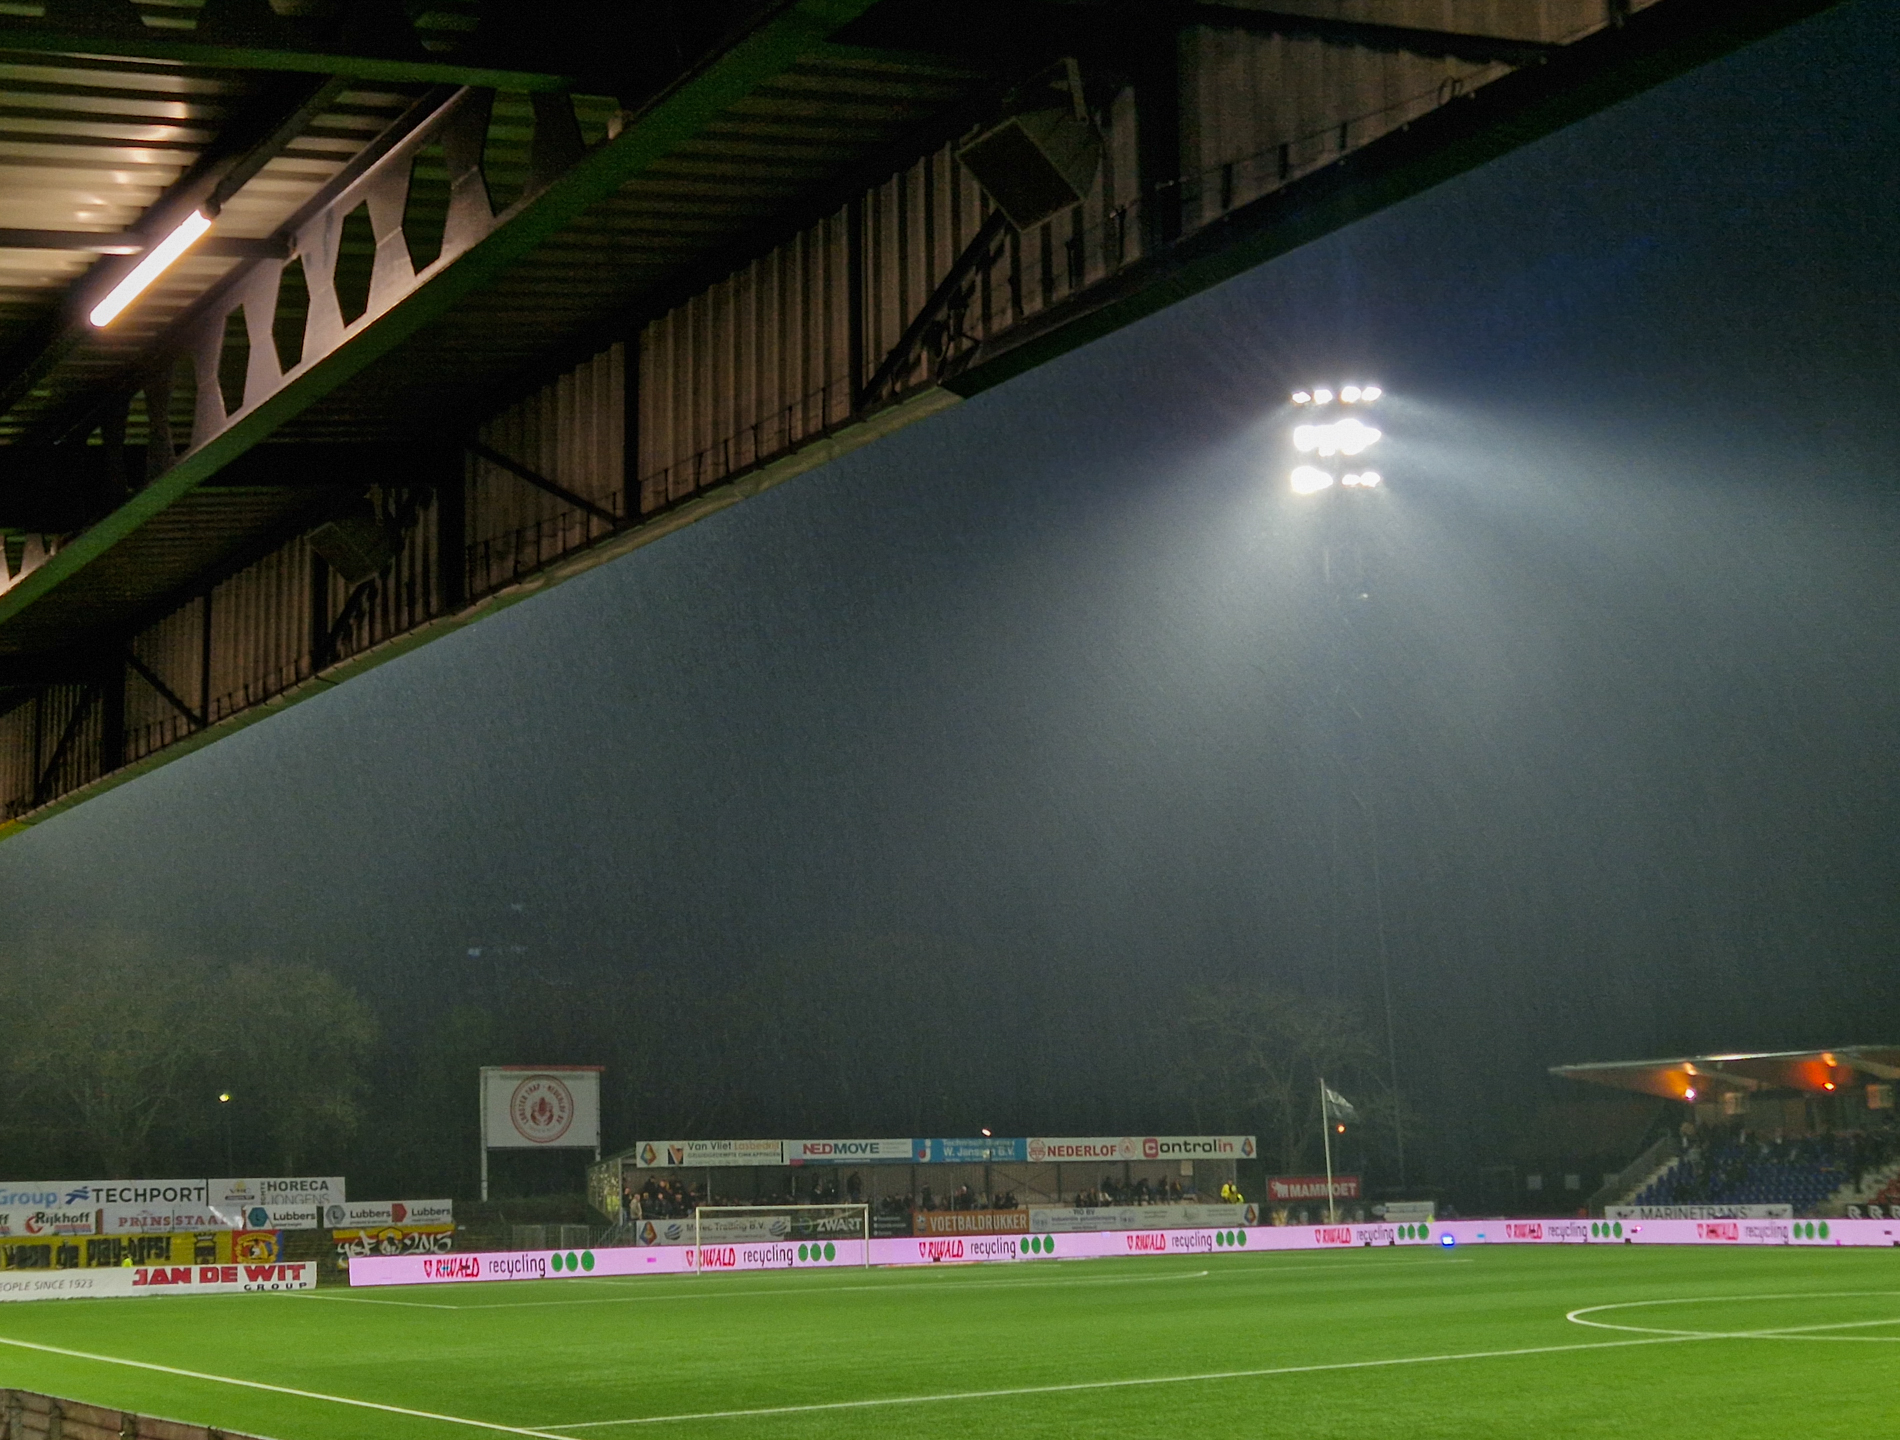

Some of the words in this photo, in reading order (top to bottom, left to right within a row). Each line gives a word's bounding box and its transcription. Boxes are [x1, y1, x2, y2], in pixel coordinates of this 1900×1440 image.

[687, 1141, 708, 1151] Van
[711, 1141, 732, 1151] Vliet
[802, 1142, 880, 1155] NEDMOVE
[1047, 1145, 1117, 1157] NEDERLOF
[1143, 1138, 1234, 1157] Controlin
[267, 1180, 329, 1192] HORECA
[1289, 1182, 1357, 1198] MAMMOET
[92, 1187, 205, 1203] TECHPORT
[267, 1193, 331, 1206] JONGENS
[36, 1211, 90, 1226] Rijkhoff
[273, 1211, 316, 1221] Lubbers
[350, 1208, 392, 1219] Lubbers
[411, 1207, 451, 1217] Lubbers
[119, 1215, 171, 1227] PRINS
[817, 1217, 863, 1232] ZWART
[930, 1214, 1028, 1232] VOETBALDRUKKER
[1135, 1233, 1166, 1251] RIWALD
[1171, 1231, 1212, 1251] recycling
[1356, 1225, 1394, 1242] recycling
[743, 1244, 793, 1267] recycling
[928, 1240, 964, 1259] RIWALD
[970, 1237, 1016, 1259] recycling
[436, 1257, 480, 1279] RIWALD
[488, 1254, 546, 1278] recycling
[132, 1267, 192, 1286] JAN
[199, 1266, 239, 1284] DE
[244, 1263, 306, 1282] WIT
[34, 1279, 64, 1291] SINCE
[69, 1279, 93, 1289] 1923
[243, 1282, 307, 1291] GROUP
